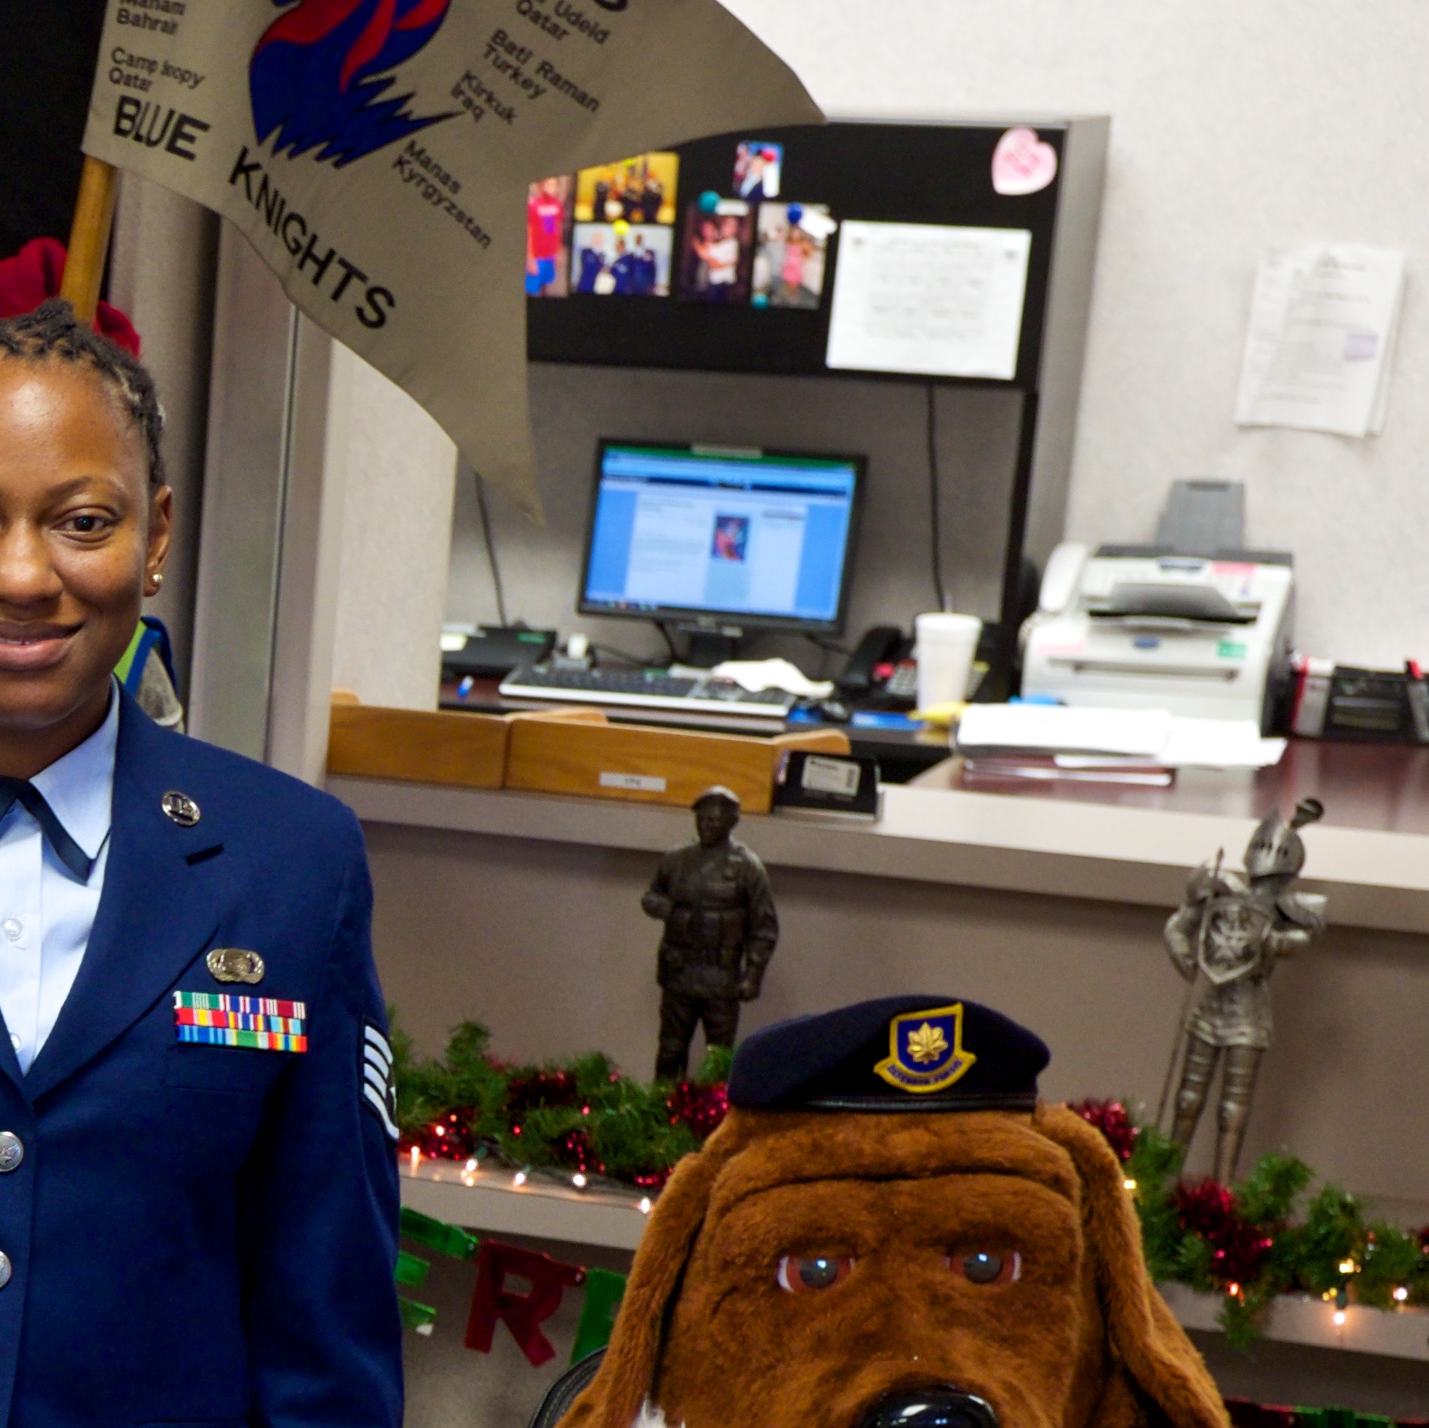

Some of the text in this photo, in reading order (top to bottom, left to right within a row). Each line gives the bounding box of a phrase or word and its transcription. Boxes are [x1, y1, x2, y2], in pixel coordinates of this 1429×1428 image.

[516, 0, 570, 42] Qatar
[461, 69, 517, 125] Kirkuk
[482, 41, 546, 100] Turkey
[535, 59, 601, 114] Raman
[114, 94, 211, 162] BLUE
[392, 154, 492, 250] Kyrgyzstan
[229, 145, 397, 331] KNIGHTS
